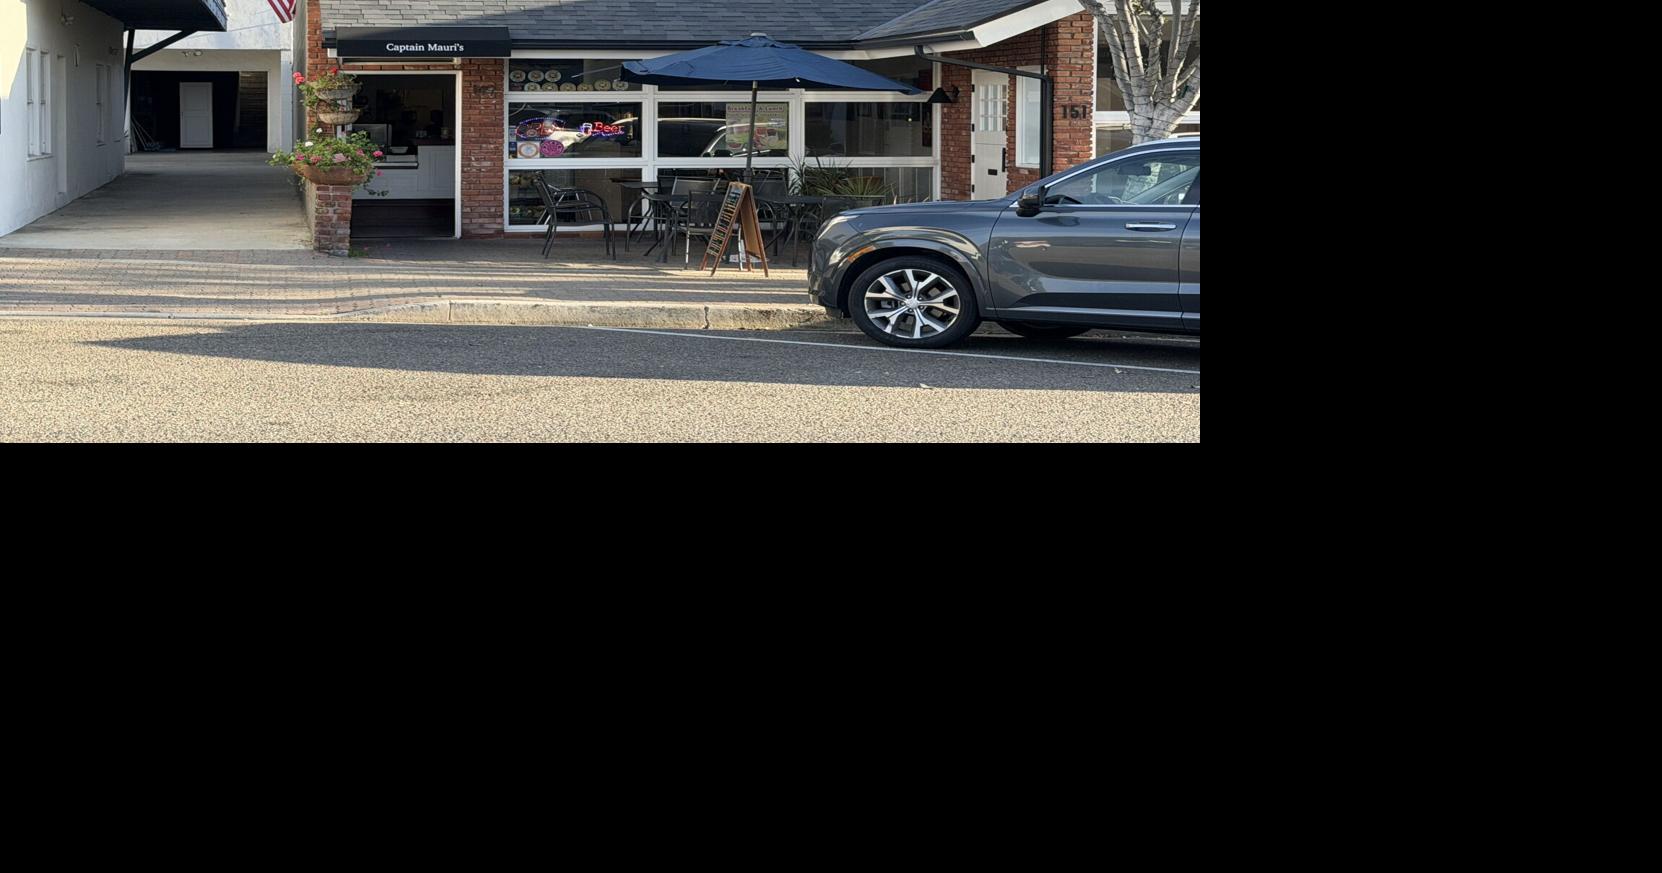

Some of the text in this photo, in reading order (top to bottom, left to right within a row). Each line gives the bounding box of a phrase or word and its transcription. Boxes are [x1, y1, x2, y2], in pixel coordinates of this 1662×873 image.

[386, 43, 465, 53] Captain Mauri's
[1061, 104, 1087, 119] 151
[593, 121, 625, 133] Beer
